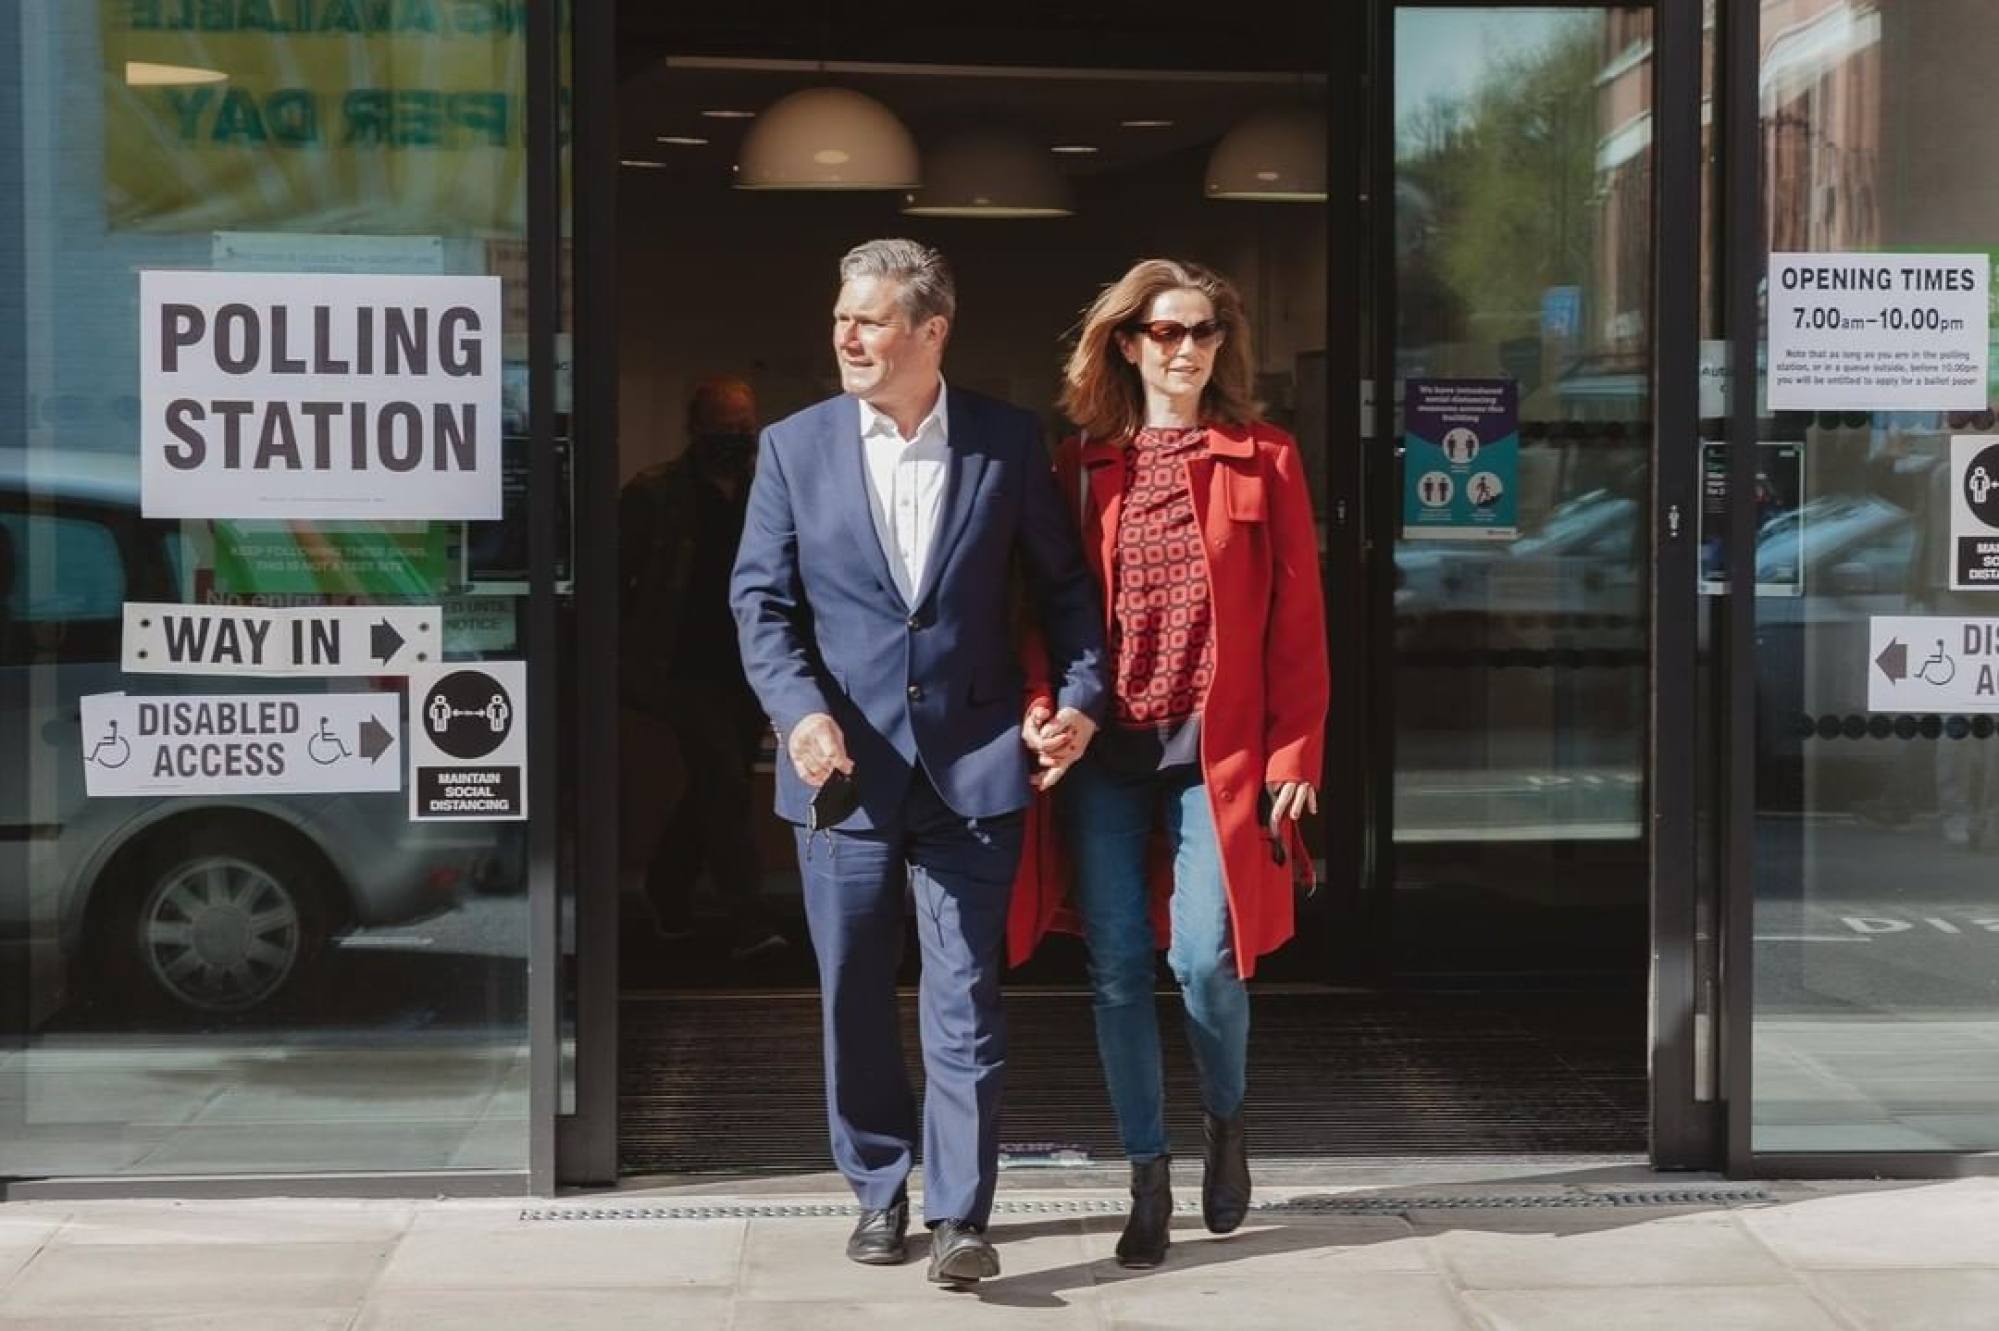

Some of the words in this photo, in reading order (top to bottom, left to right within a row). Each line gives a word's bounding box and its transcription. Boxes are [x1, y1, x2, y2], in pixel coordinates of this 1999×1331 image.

[1781, 267, 1892, 290] OPENING
[1900, 268, 1975, 291] TIMES
[161, 303, 482, 376] POLLING
[162, 398, 477, 472] STATION
[163, 616, 272, 665] WAY
[292, 619, 340, 665] IN
[1975, 664, 1999, 696] A
[138, 702, 299, 736] DISABLED
[152, 743, 286, 778] ACCESS
[438, 772, 501, 784] MAINTAIN
[445, 786, 496, 797] SOCIAL
[429, 799, 510, 811] DISTANCING
